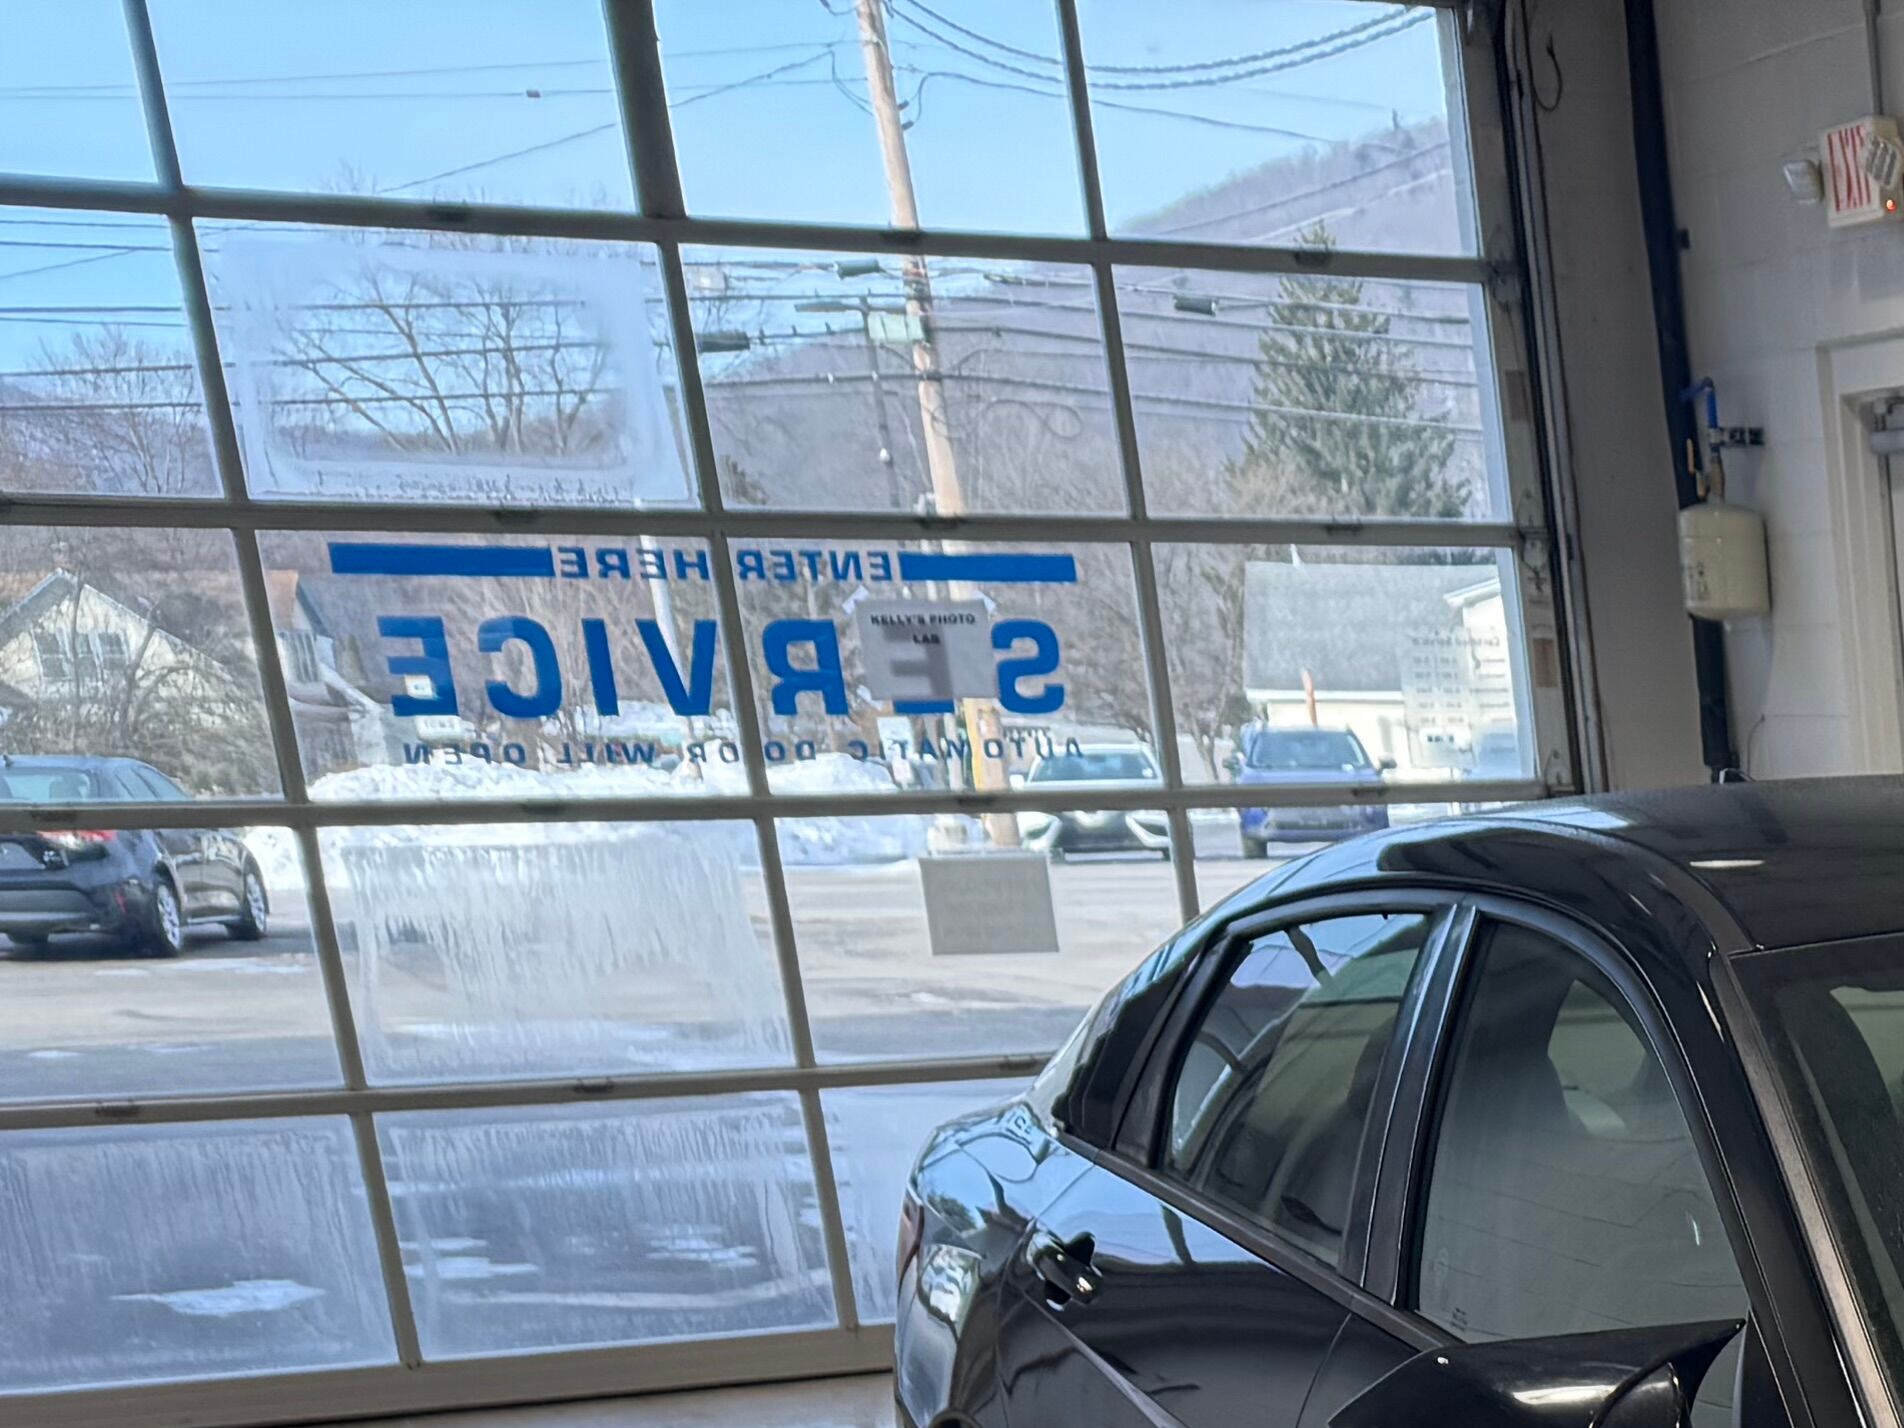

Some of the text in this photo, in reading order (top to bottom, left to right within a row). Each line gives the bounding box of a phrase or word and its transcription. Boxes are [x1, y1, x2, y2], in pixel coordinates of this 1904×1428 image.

[871, 614, 975, 625] KELLY'S PHOTO
[913, 634, 940, 645] LAB
